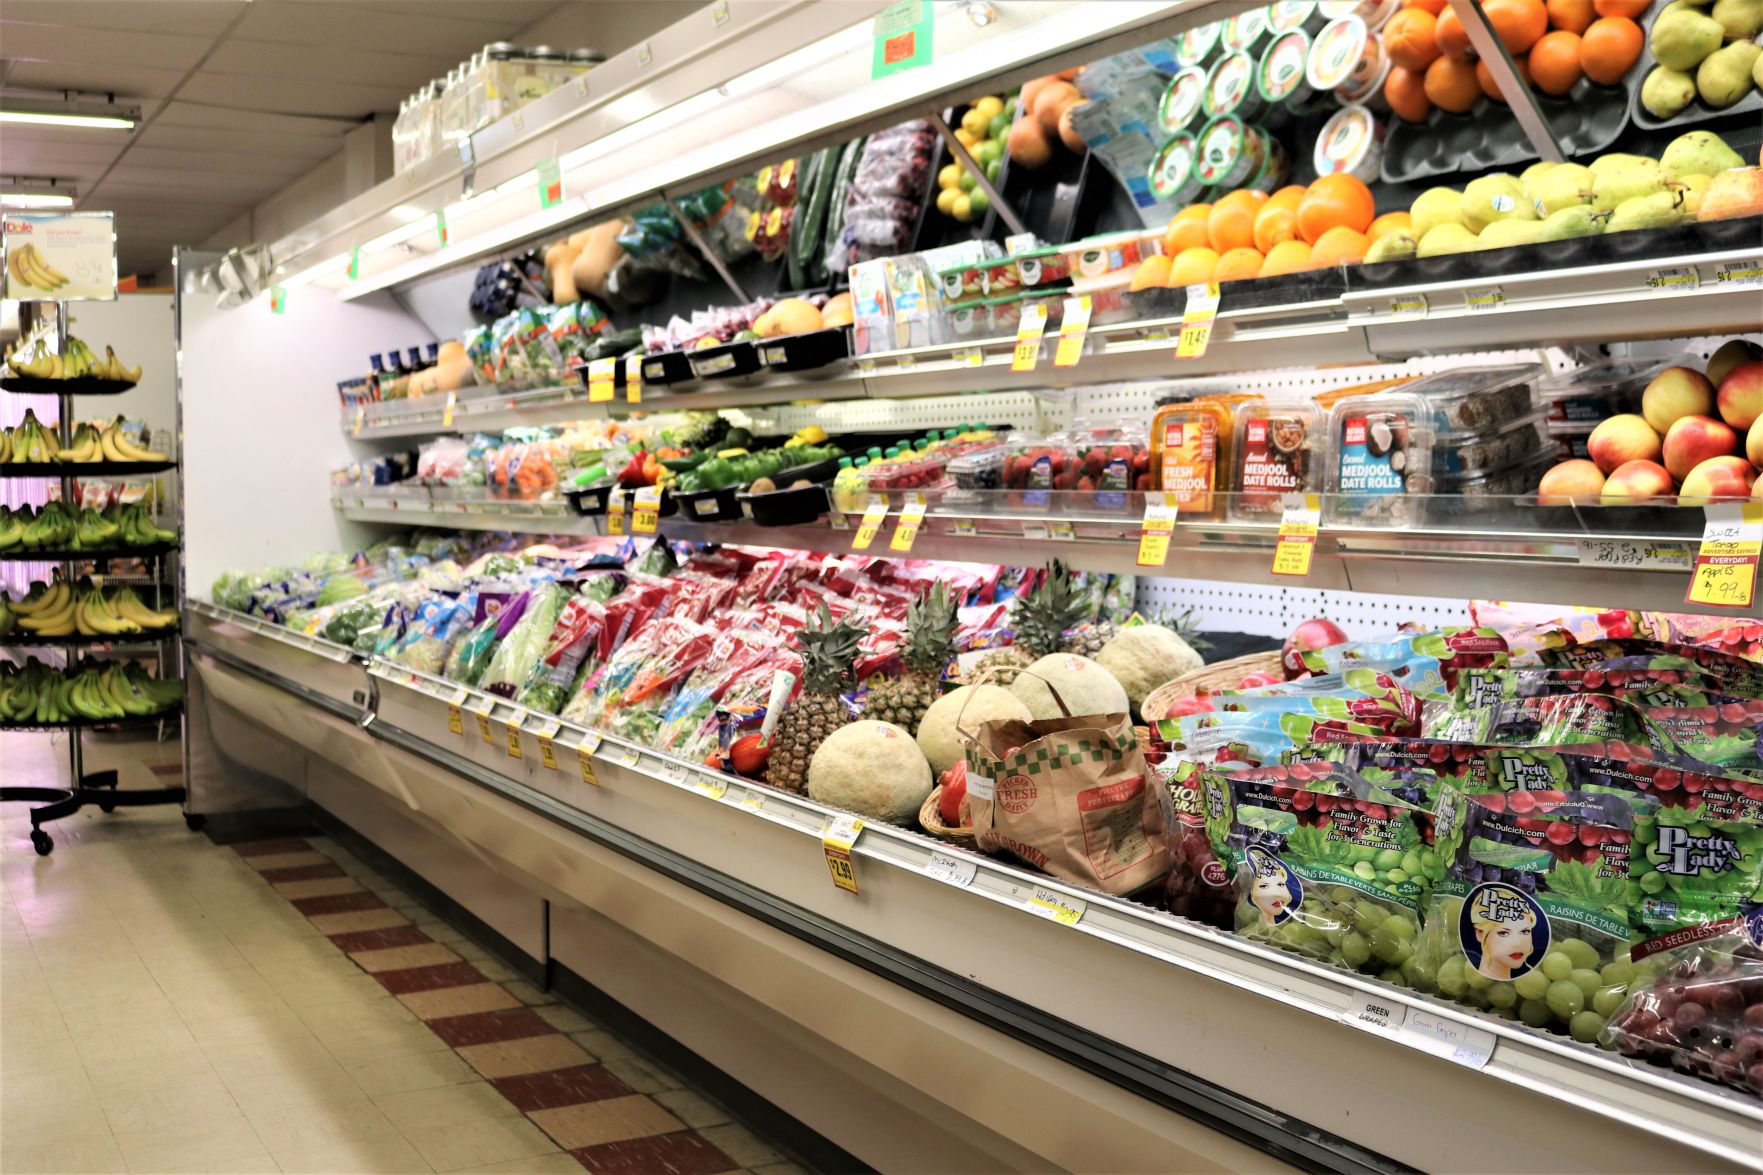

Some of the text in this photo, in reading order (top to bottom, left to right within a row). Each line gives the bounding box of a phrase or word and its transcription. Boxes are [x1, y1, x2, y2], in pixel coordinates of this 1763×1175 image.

[7, 223, 32, 234] Dole
[1164, 467, 1193, 476] FRESH
[1244, 464, 1288, 475] MEDJOOL
[1342, 464, 1392, 476] MEDJOOL
[1164, 478, 1207, 489] MEDJOOL
[1243, 475, 1296, 487] DATE ROLLS
[1341, 476, 1401, 488] DATE ROLLS
[1375, 751, 1428, 760] www.Dulcich.com
[1502, 757, 1552, 783] Pretty
[1589, 766, 1653, 784] www.Dulcich.com
[1002, 777, 1029, 789] PICKED
[996, 788, 1037, 801] FRESH
[1245, 791, 1292, 804] www.Dulcich.com
[1702, 789, 1735, 804] Family
[1005, 801, 1028, 811] DAILY
[1707, 803, 1751, 817] Flavor &
[1330, 810, 1403, 829] Family Grown for
[1334, 822, 1359, 833] Flavor
[1372, 829, 1396, 839] Taste
[1482, 820, 1545, 838] www.Dulcich.com
[1326, 832, 1342, 842] for
[1656, 826, 1741, 860] Pretty
[1002, 836, 1050, 868] GROWN
[1671, 847, 1728, 875] Lady
[829, 858, 852, 881] $2.99
[1208, 872, 1226, 881] 4276
[1596, 868, 1613, 880] for
[1290, 865, 1317, 878] RAISINS
[1319, 870, 1330, 879] DE
[1331, 874, 1354, 886] TABLE
[1354, 880, 1376, 895] VERTS
[1377, 890, 1399, 901] SANS
[1480, 888, 1530, 914] Pretty
[1487, 904, 1522, 923] Lady
[1550, 904, 1625, 934] RAISINS DE TABLE
[1645, 940, 1663, 953] RED
[1665, 925, 1714, 947] SEEDLESS
[1366, 1004, 1390, 1018] GREEN
